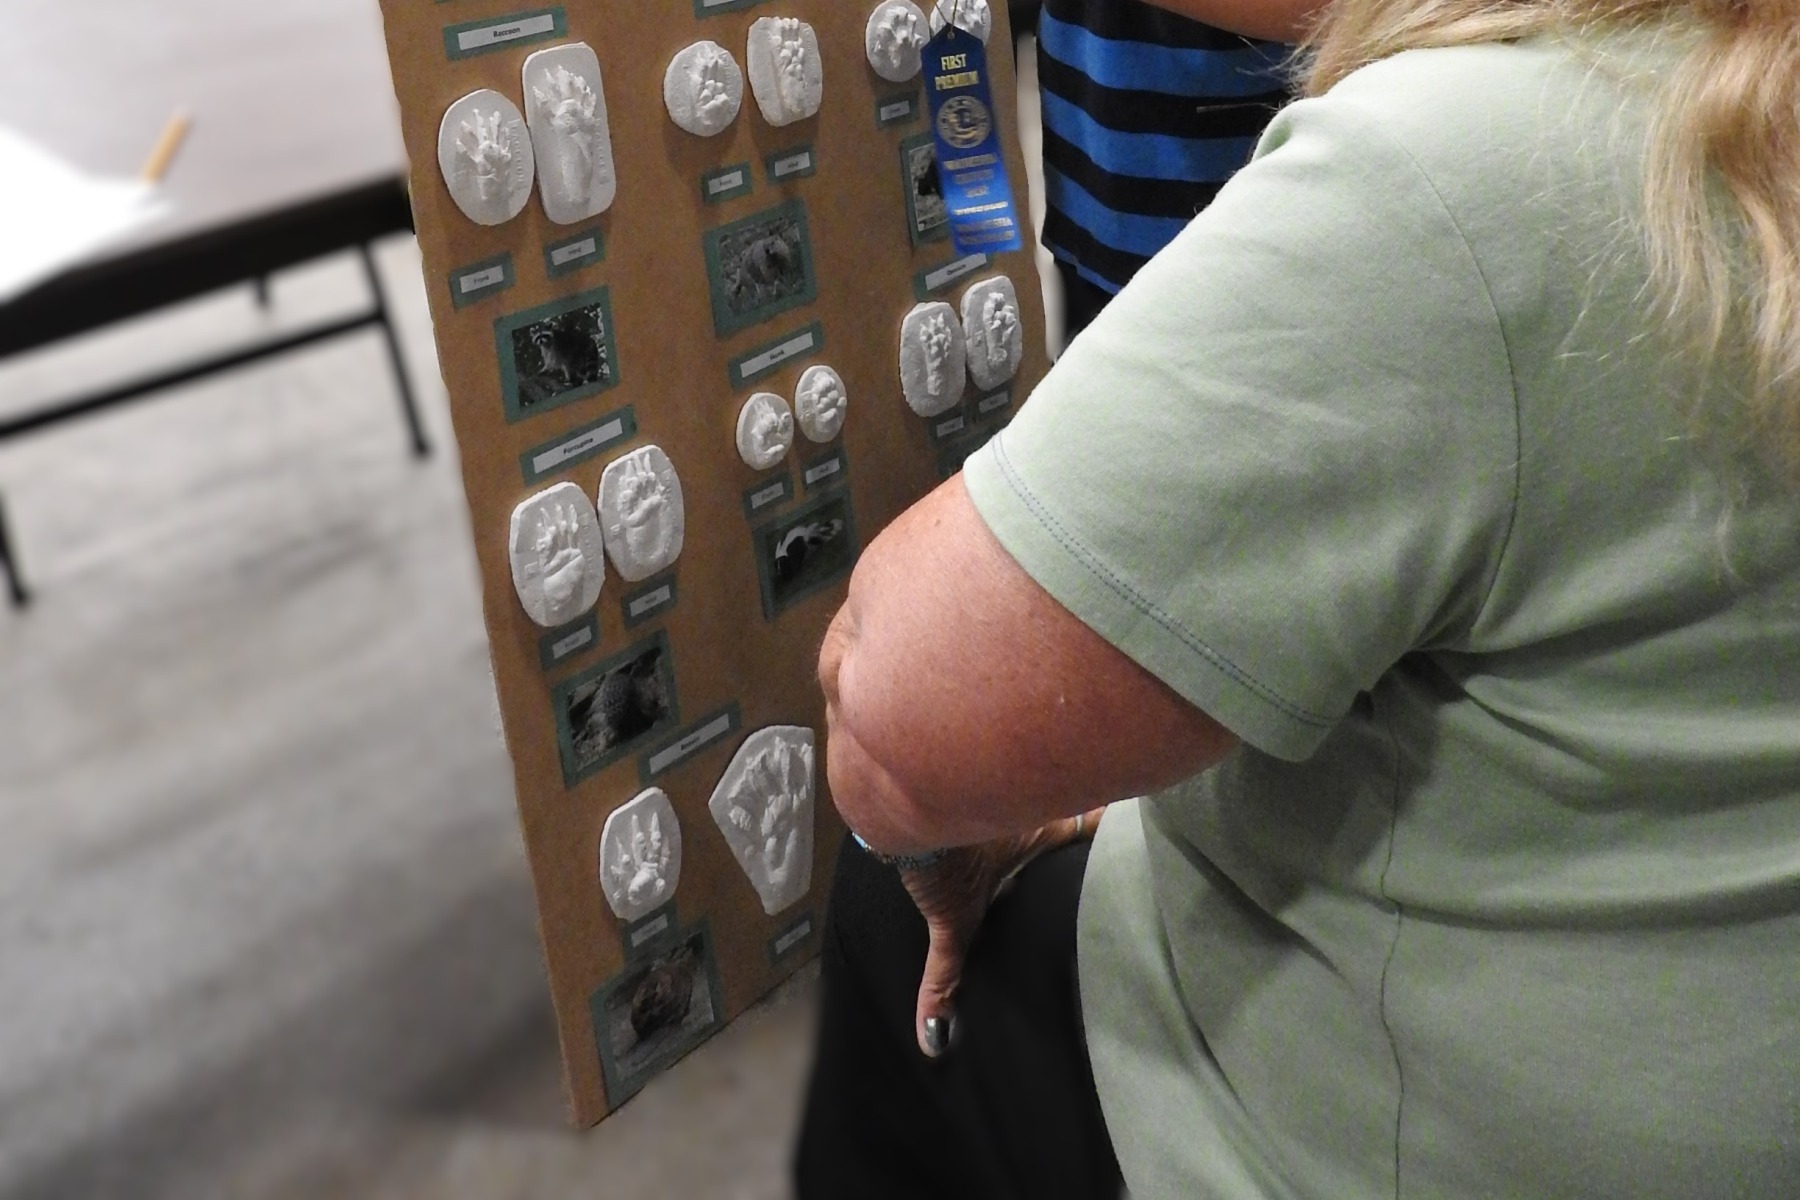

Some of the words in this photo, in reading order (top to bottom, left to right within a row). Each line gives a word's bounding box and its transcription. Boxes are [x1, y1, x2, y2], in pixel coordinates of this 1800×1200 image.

[493, 27, 521, 38] Raccoon
[940, 53, 967, 71] FIRST
[563, 437, 594, 455] Porcupine
